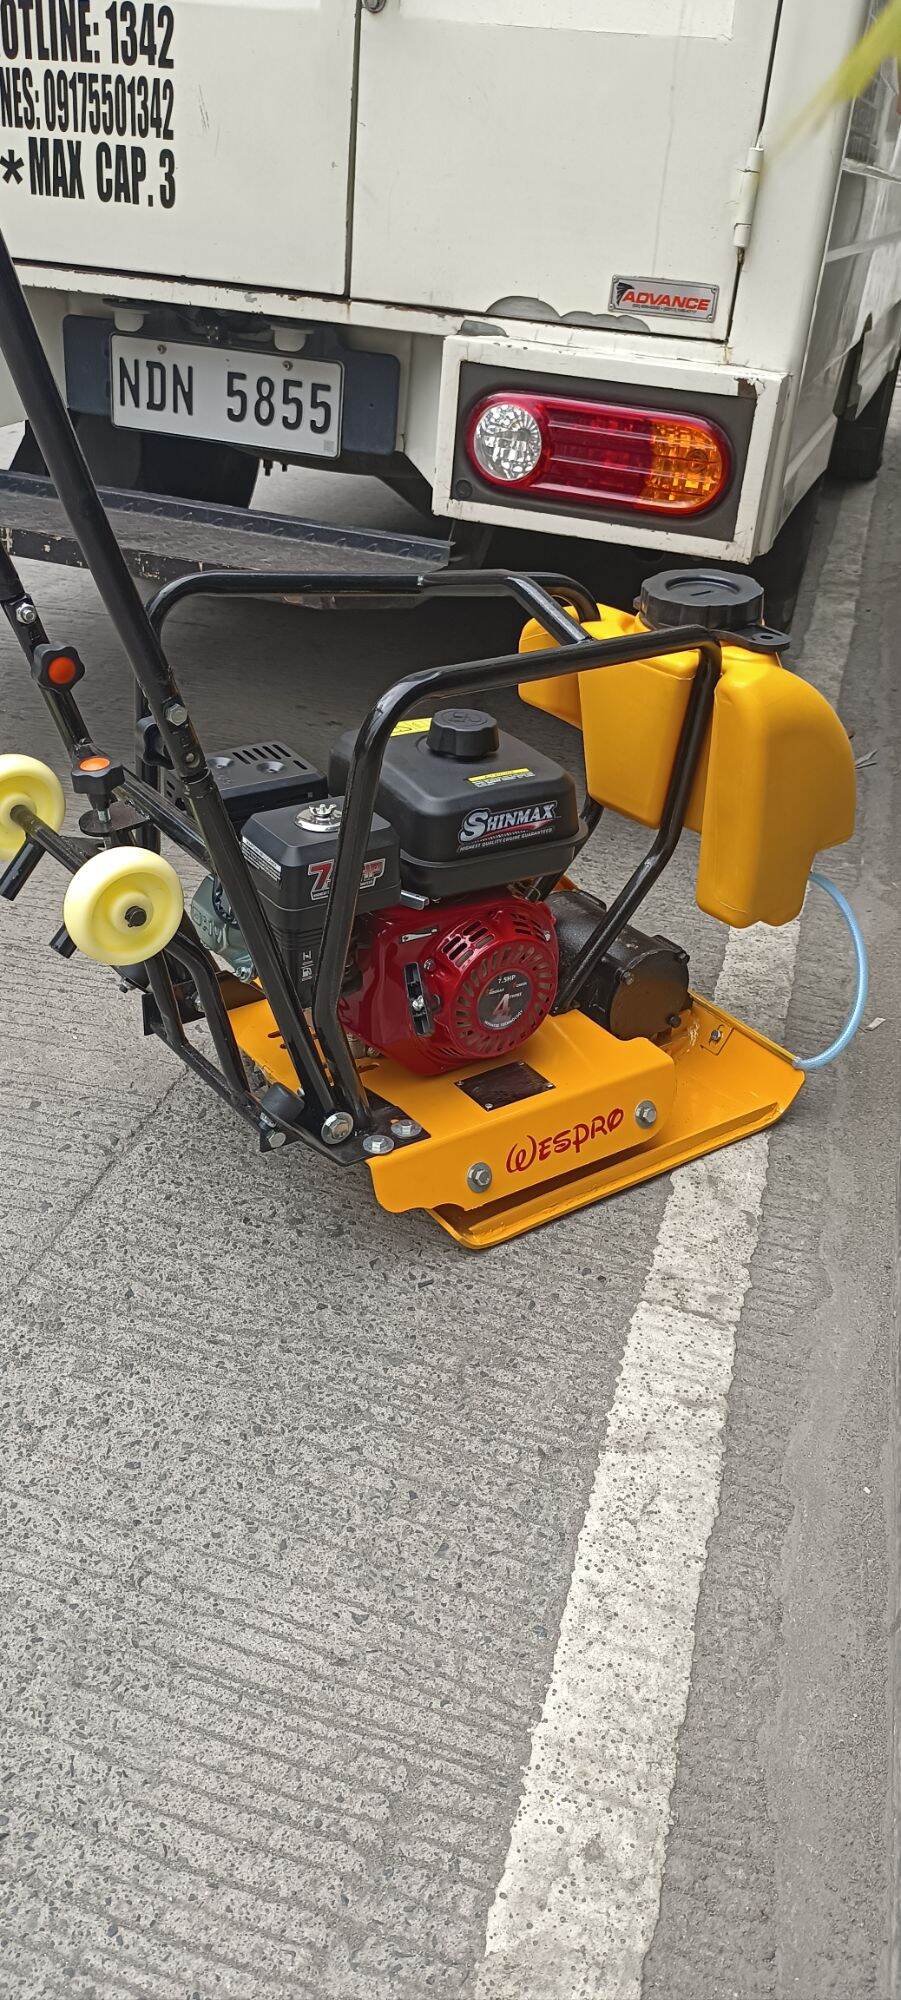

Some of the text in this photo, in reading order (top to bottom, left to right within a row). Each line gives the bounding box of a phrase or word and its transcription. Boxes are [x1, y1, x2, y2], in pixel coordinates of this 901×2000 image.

[105, 1, 175, 69] 1342
[43, 68, 174, 141] 09175501342
[159, 148, 176, 209] 3
[621, 291, 711, 311] ADVANCE
[119, 356, 332, 434] NDN 5855
[459, 802, 556, 842] SHINMAX
[497, 974, 516, 984] 7.5HP
[505, 1107, 625, 1174] WESPRO
